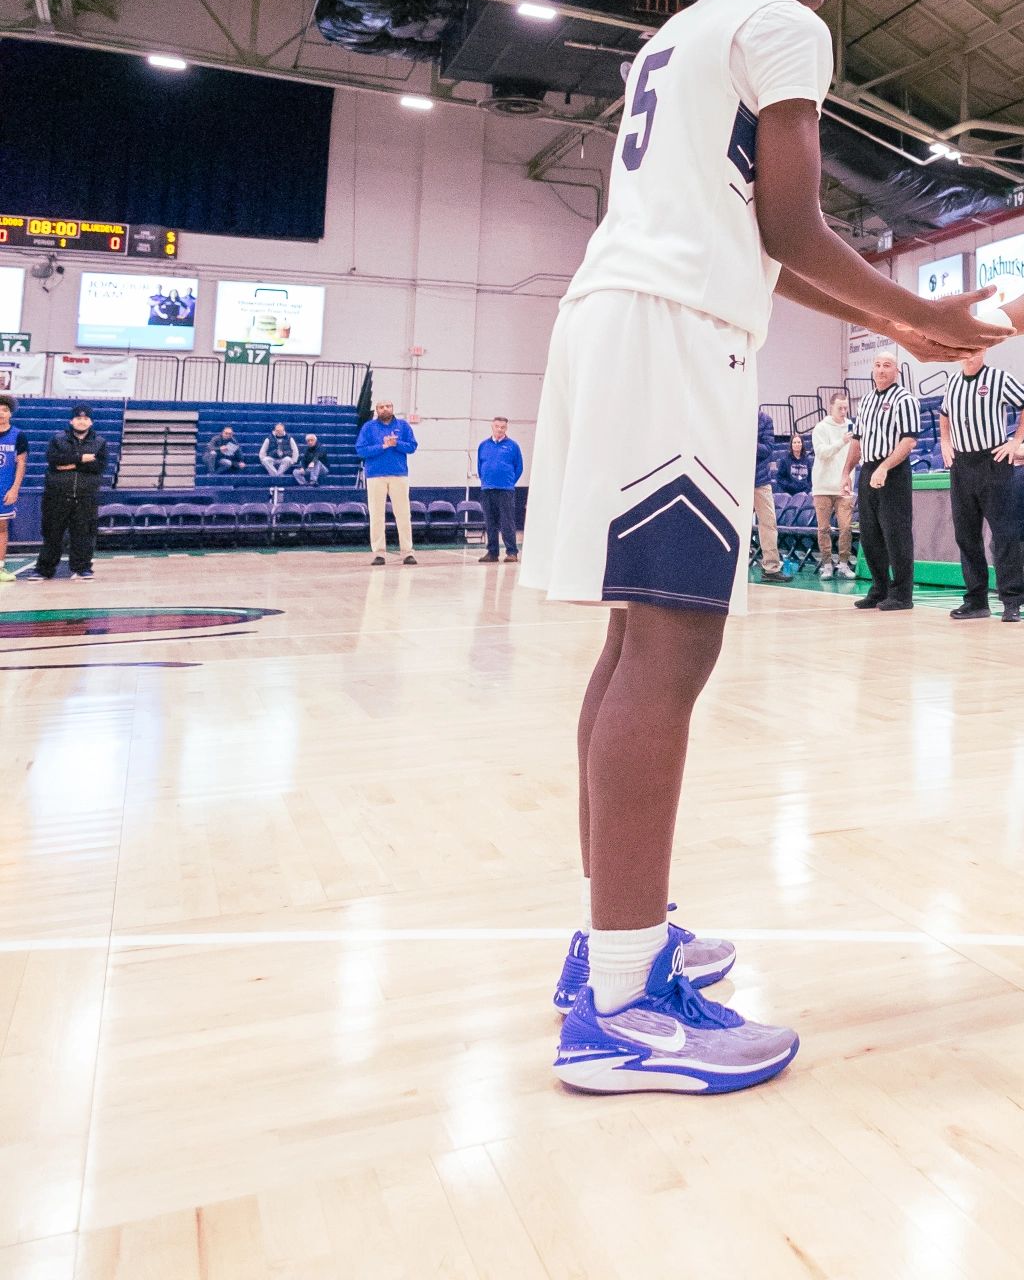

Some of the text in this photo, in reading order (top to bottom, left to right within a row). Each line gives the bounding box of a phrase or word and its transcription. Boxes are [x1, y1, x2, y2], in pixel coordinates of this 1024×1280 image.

[621, 46, 676, 172] 5
[29, 219, 78, 237] 08:00
[110, 237, 121, 250] 0
[979, 255, 1024, 288] Oakhurst
[246, 349, 267, 364] 17
